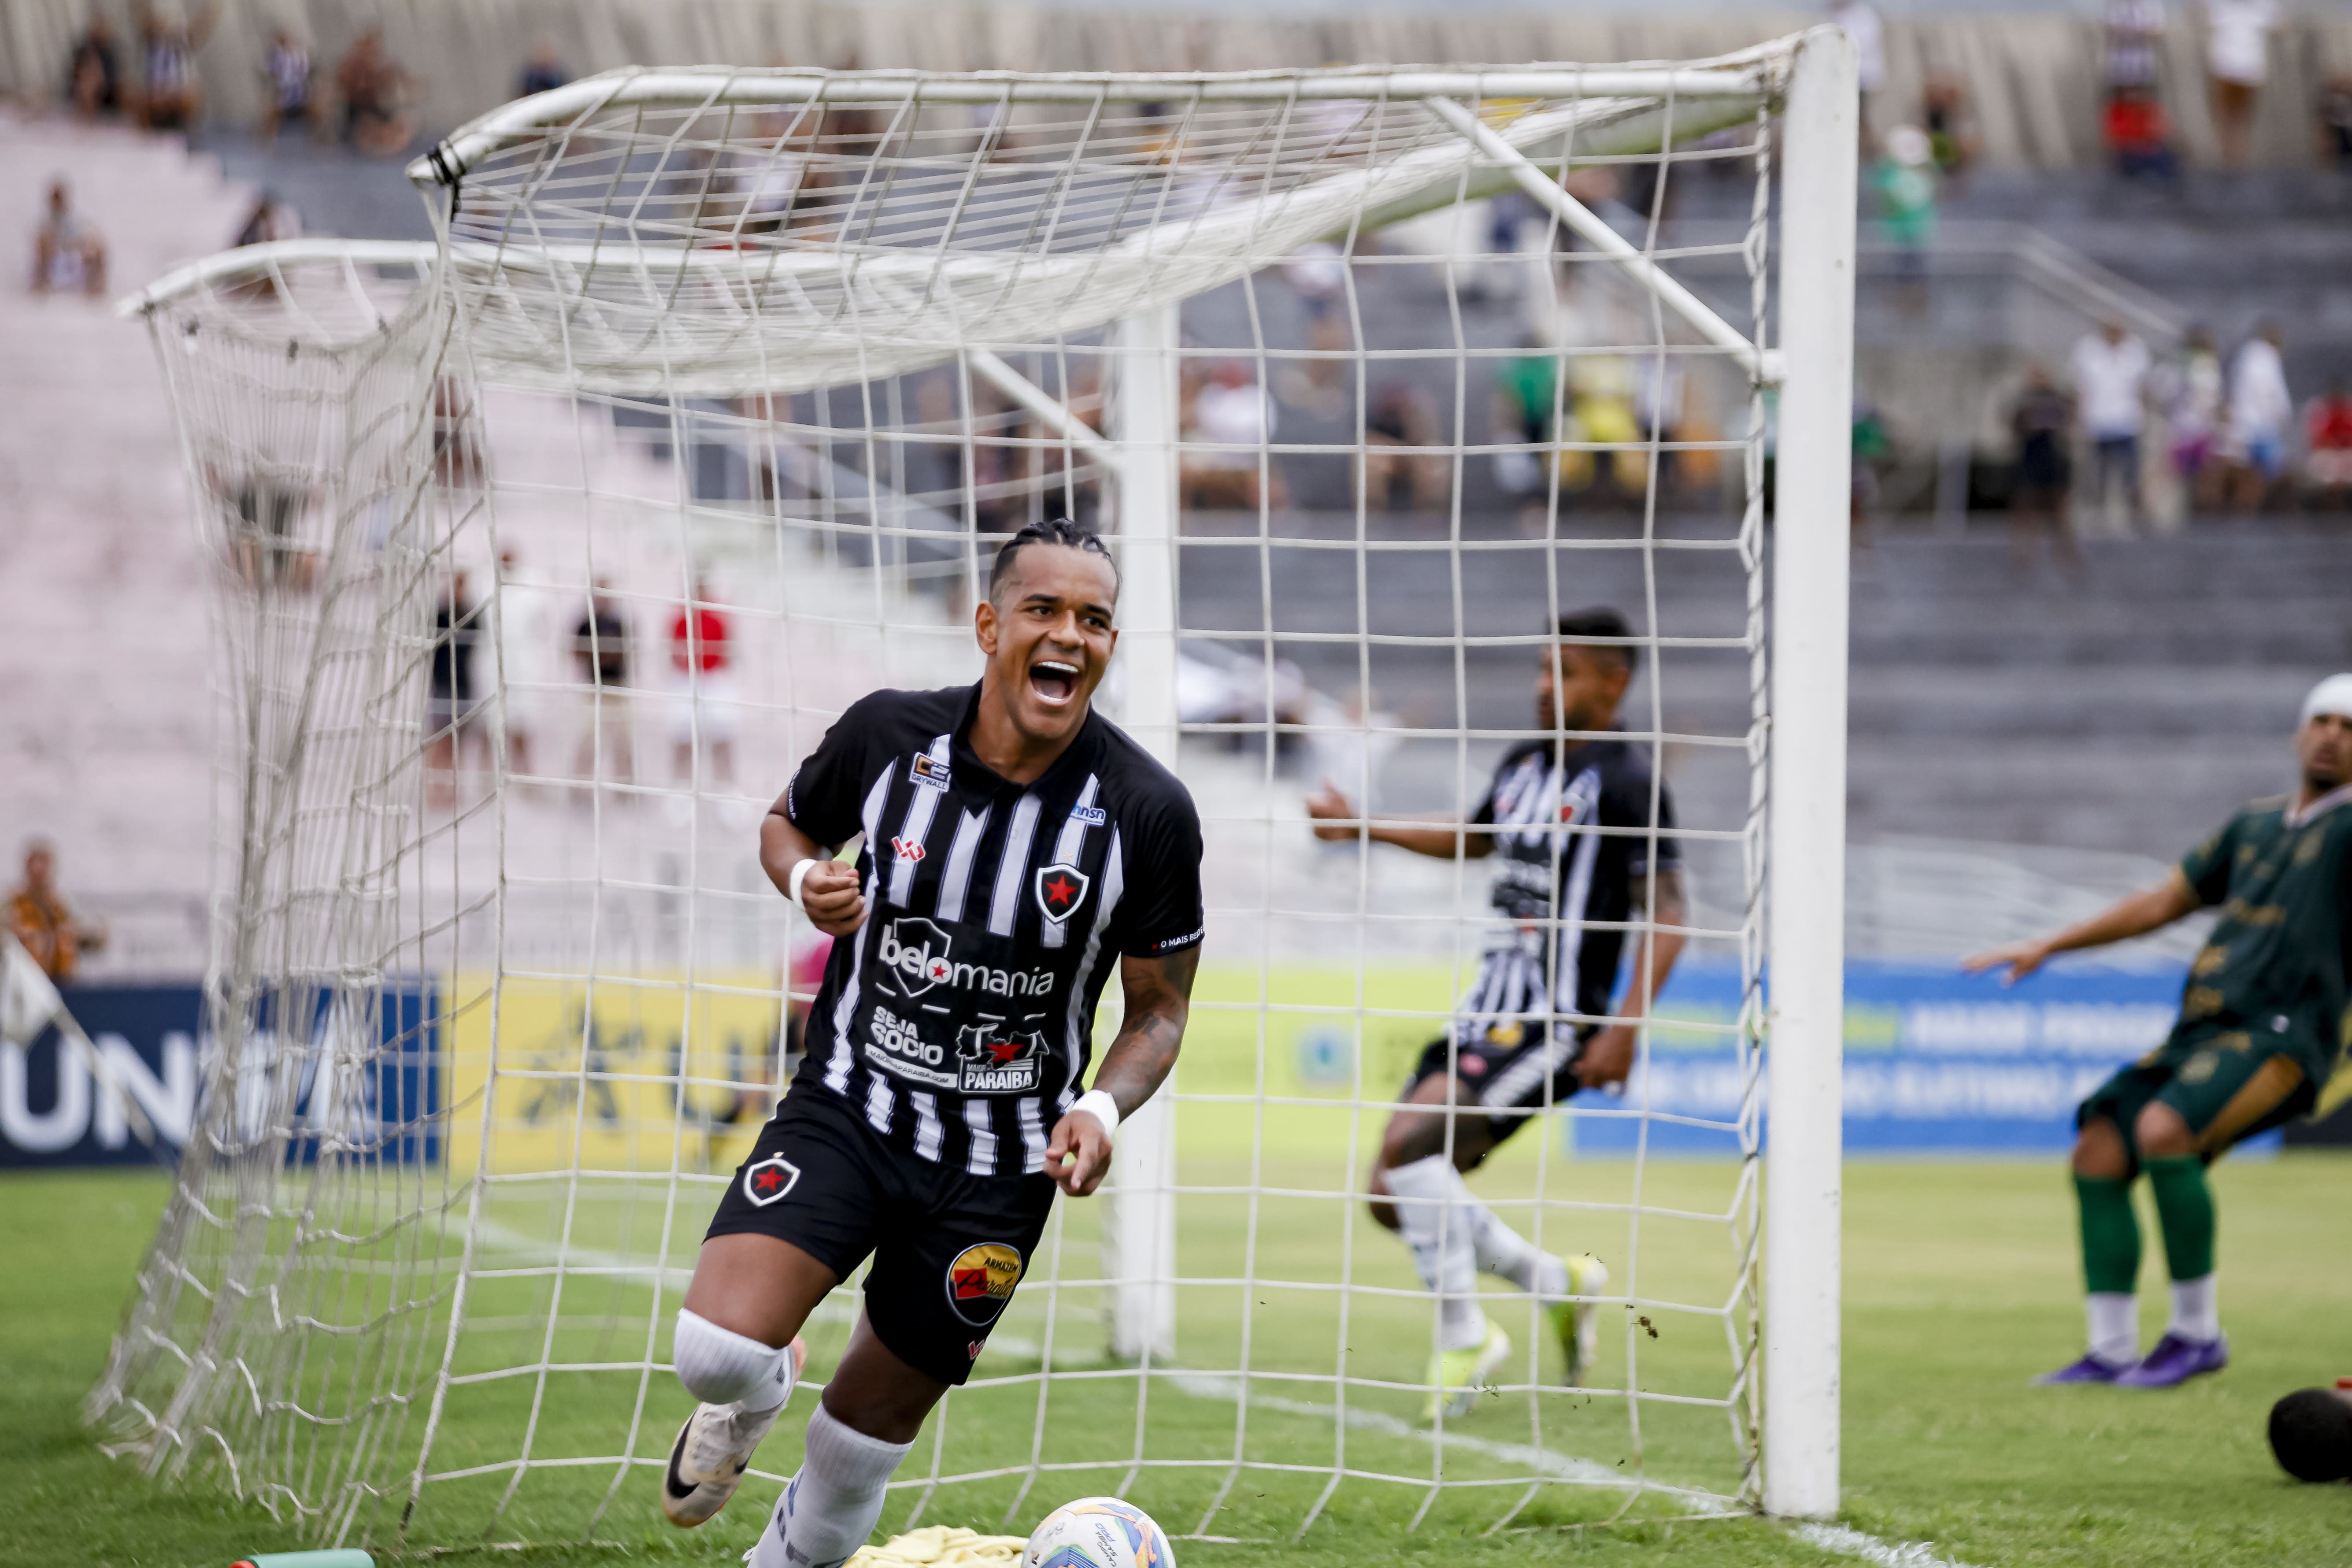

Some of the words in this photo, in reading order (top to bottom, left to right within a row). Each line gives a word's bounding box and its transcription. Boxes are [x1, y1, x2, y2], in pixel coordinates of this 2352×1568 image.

[912, 775, 946, 790] DRYWALL
[1169, 935, 1188, 946] MAIS
[880, 924, 1054, 997] belomania
[874, 1006, 918, 1039] SEJA
[965, 1071, 1032, 1089] PARAÍBA
[1095, 1523, 1116, 1542] PRO
[1096, 1531, 1119, 1556] SAMBA
